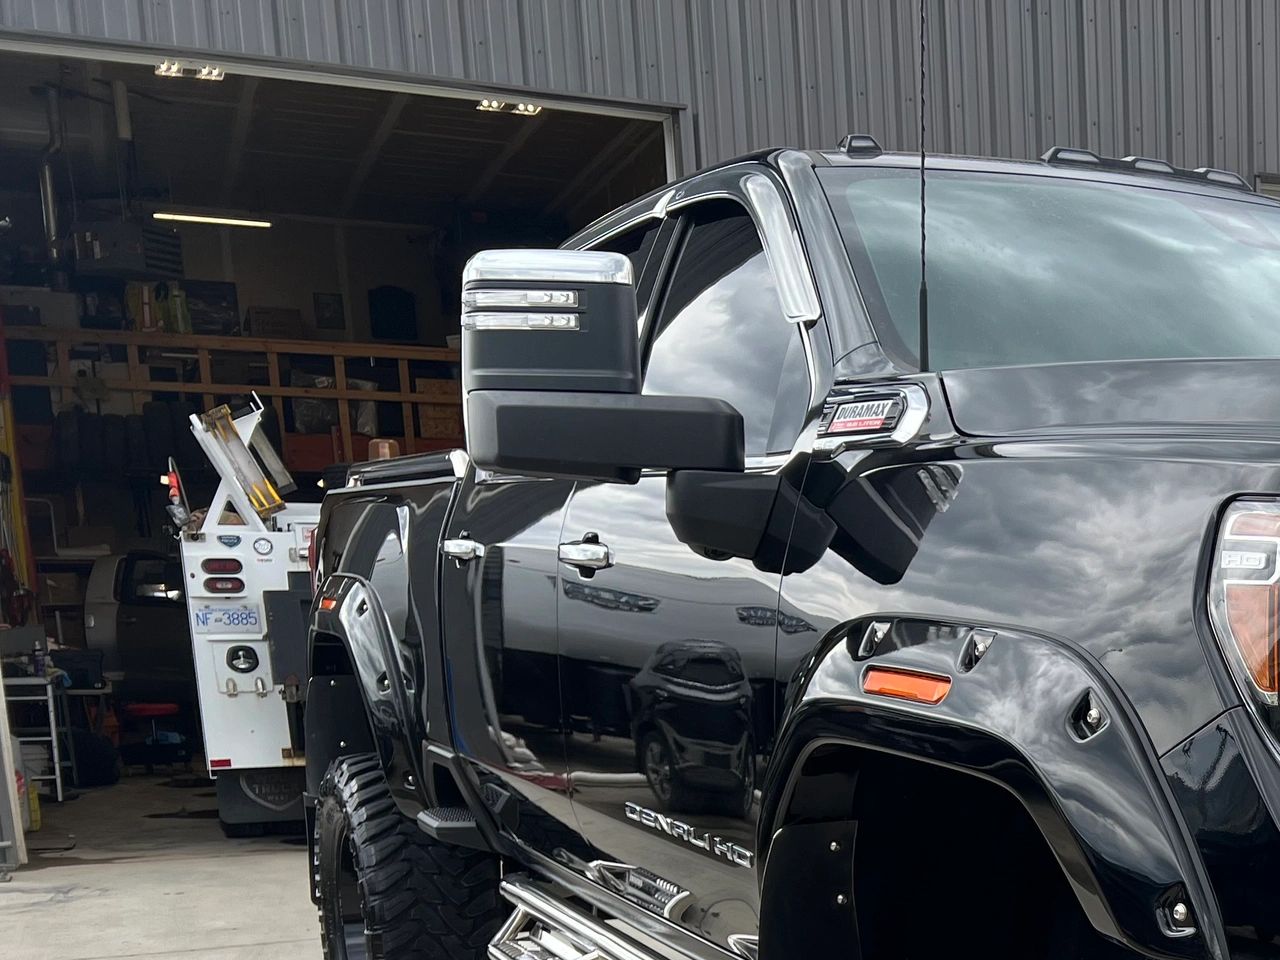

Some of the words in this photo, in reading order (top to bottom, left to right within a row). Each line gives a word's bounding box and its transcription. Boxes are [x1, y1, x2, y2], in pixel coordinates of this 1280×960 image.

[836, 402, 889, 420] DURAMAX
[196, 612, 212, 626] NF
[222, 612, 257, 626] 3885
[625, 801, 711, 851] DENALI
[713, 837, 754, 868] HD
